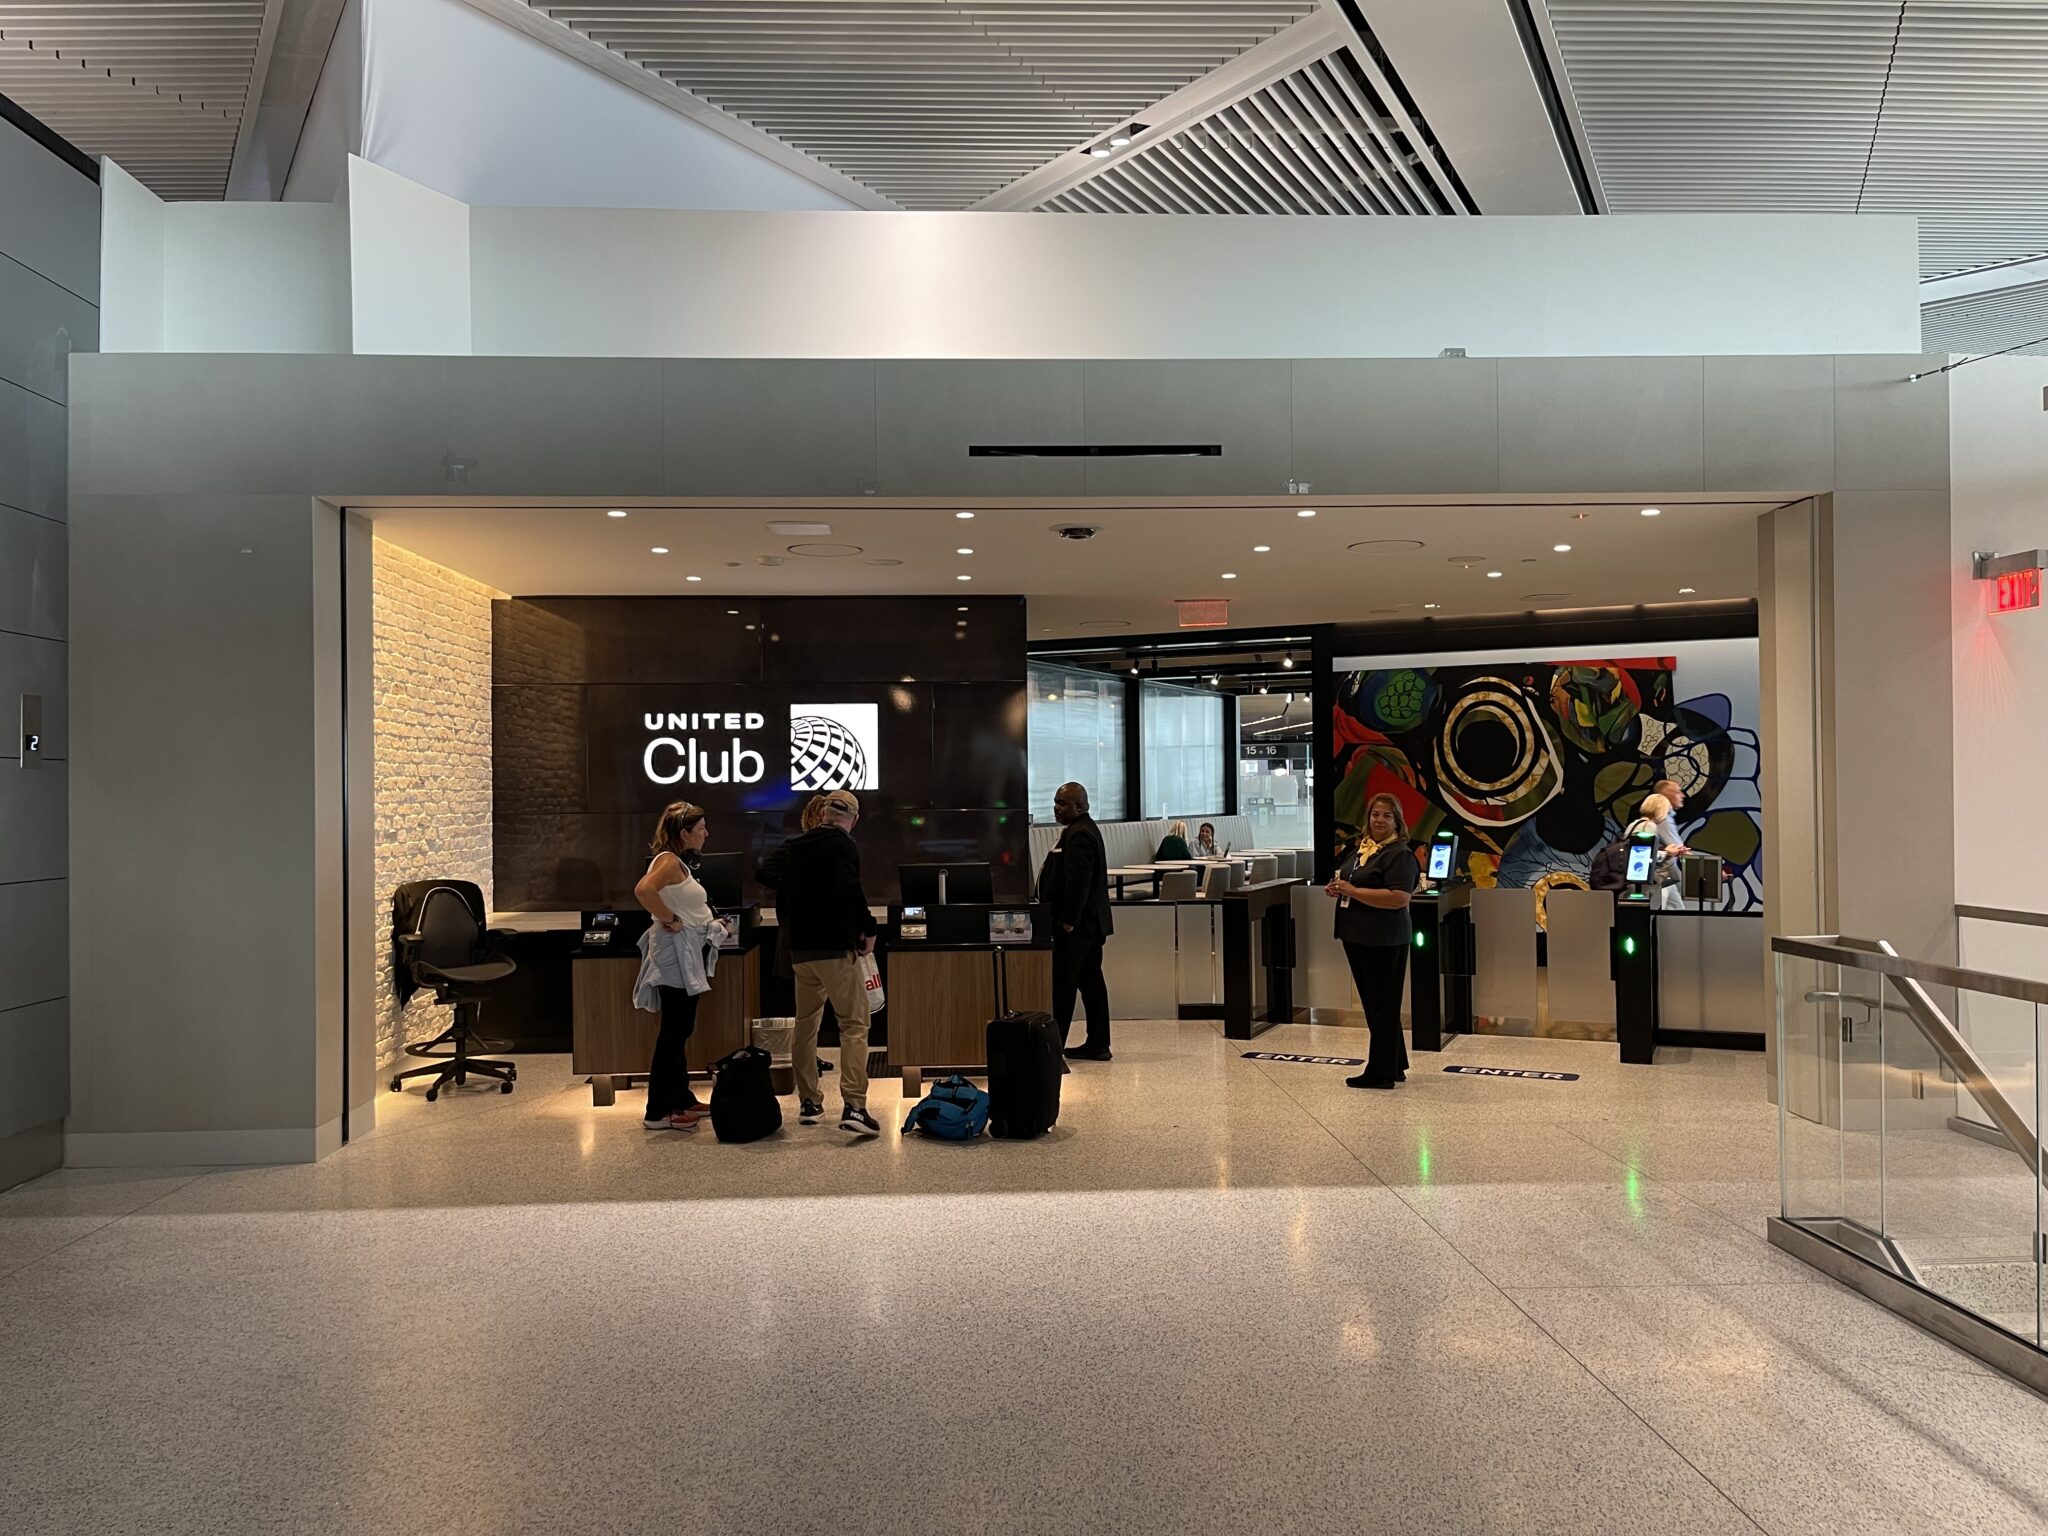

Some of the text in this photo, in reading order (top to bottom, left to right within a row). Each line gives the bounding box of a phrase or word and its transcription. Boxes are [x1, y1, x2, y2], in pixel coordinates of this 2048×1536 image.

[1998, 571, 2033, 611] EXIT
[644, 713, 764, 730] UNITED
[31, 735, 39, 751] 2
[1245, 746, 1277, 755] 15 16
[644, 737, 764, 784] Club
[1255, 1053, 1350, 1065] ENTER
[1459, 1067, 1563, 1080] ENTER
